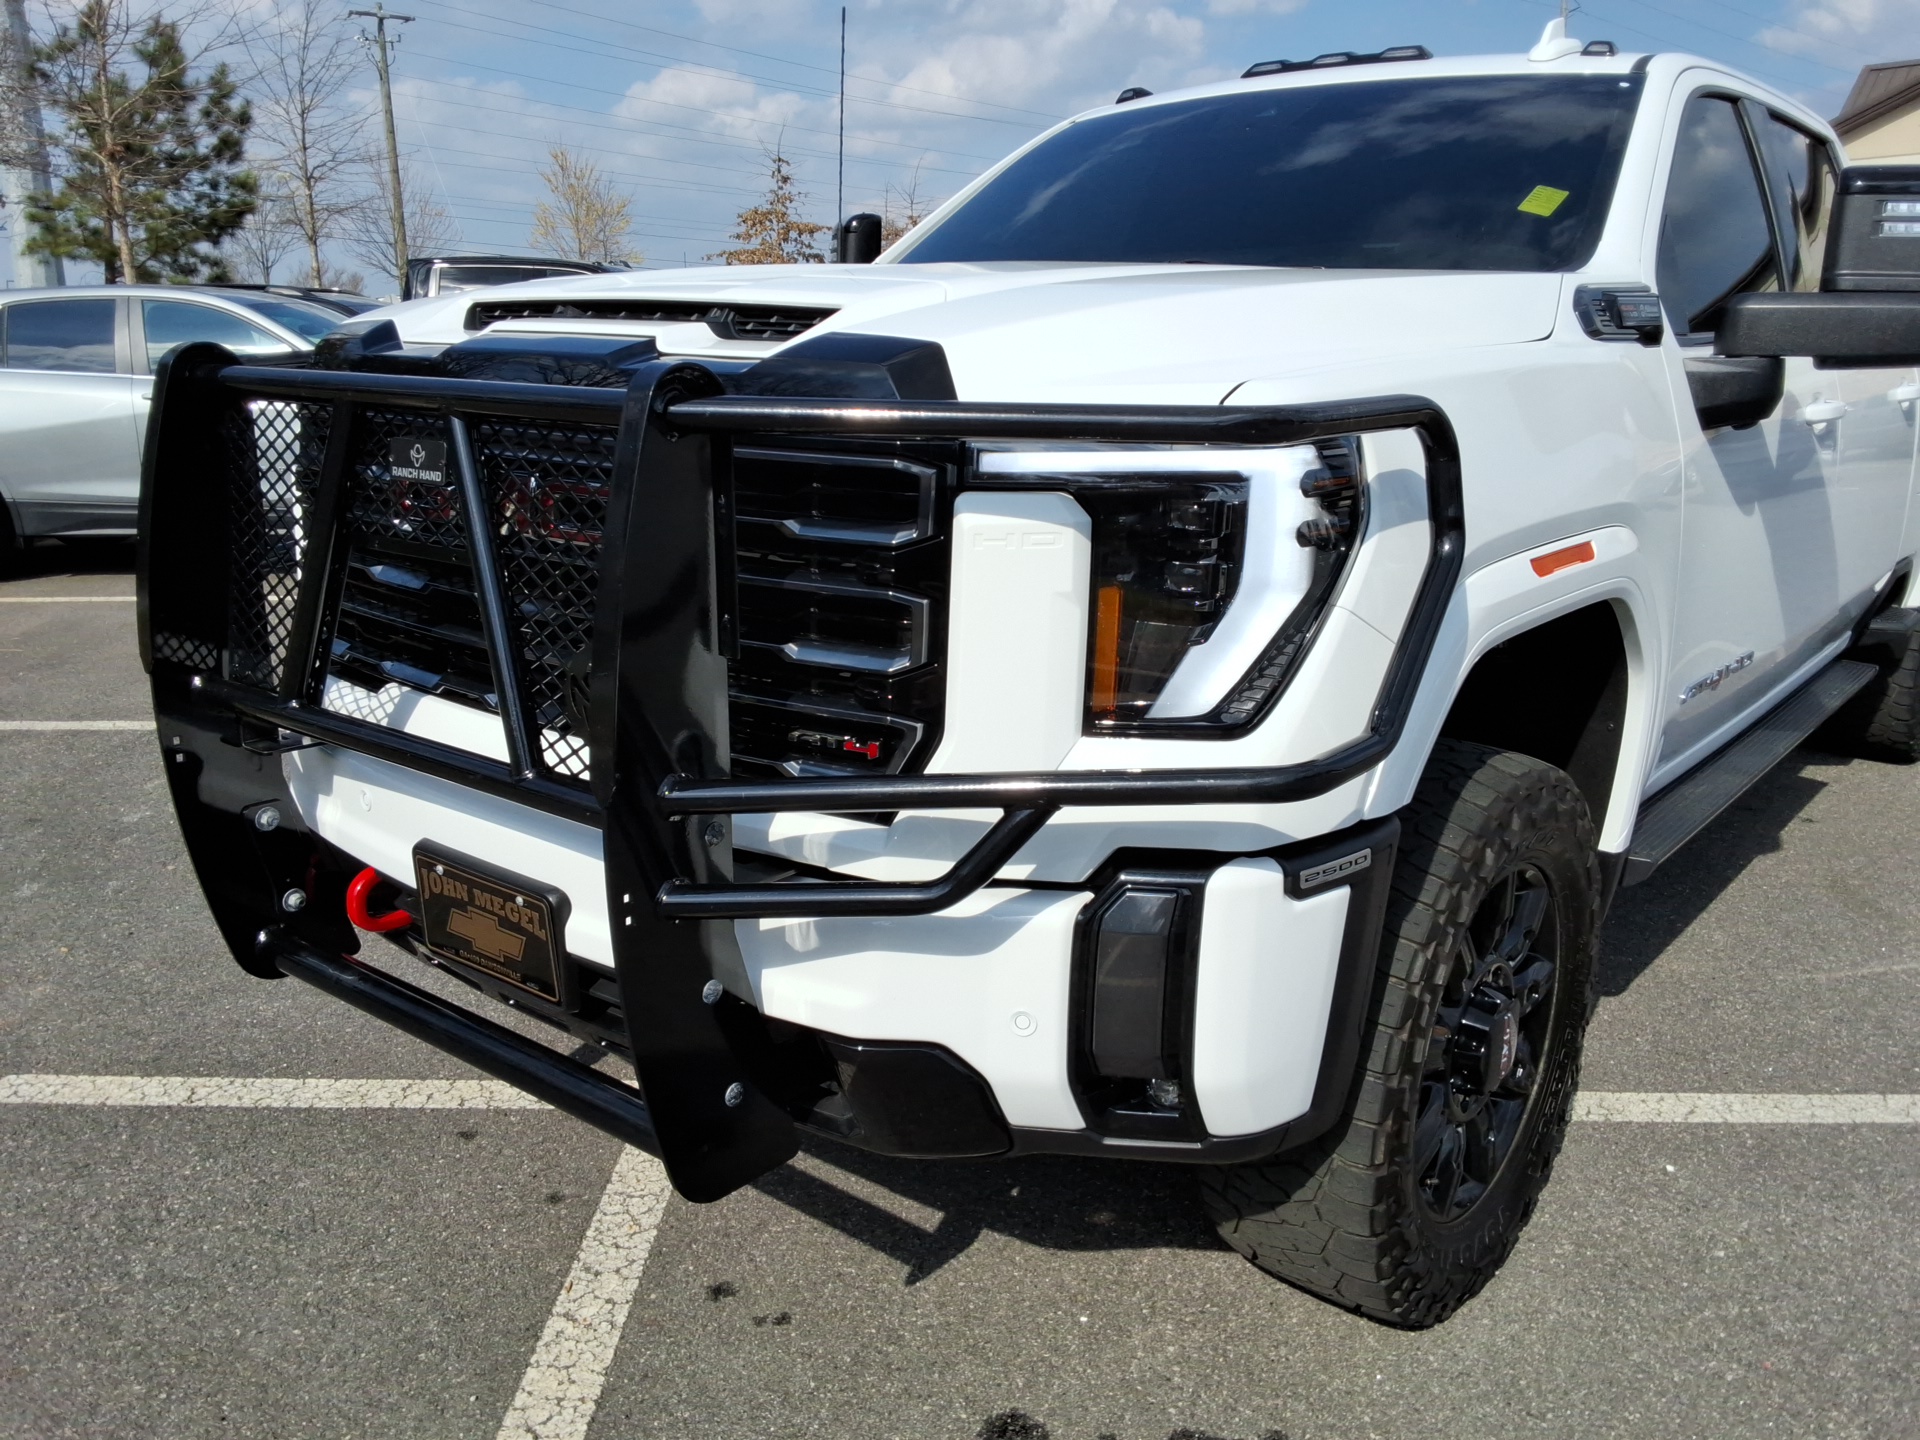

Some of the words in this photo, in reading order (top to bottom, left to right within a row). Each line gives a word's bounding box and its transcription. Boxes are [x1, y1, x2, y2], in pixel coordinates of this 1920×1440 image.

[392, 466, 419, 479] RANCH
[419, 469, 442, 481] HAND
[972, 532, 1064, 550] HD
[1304, 854, 1368, 883] 2500
[420, 867, 469, 902] JOHN
[472, 888, 547, 941] MEGEL
